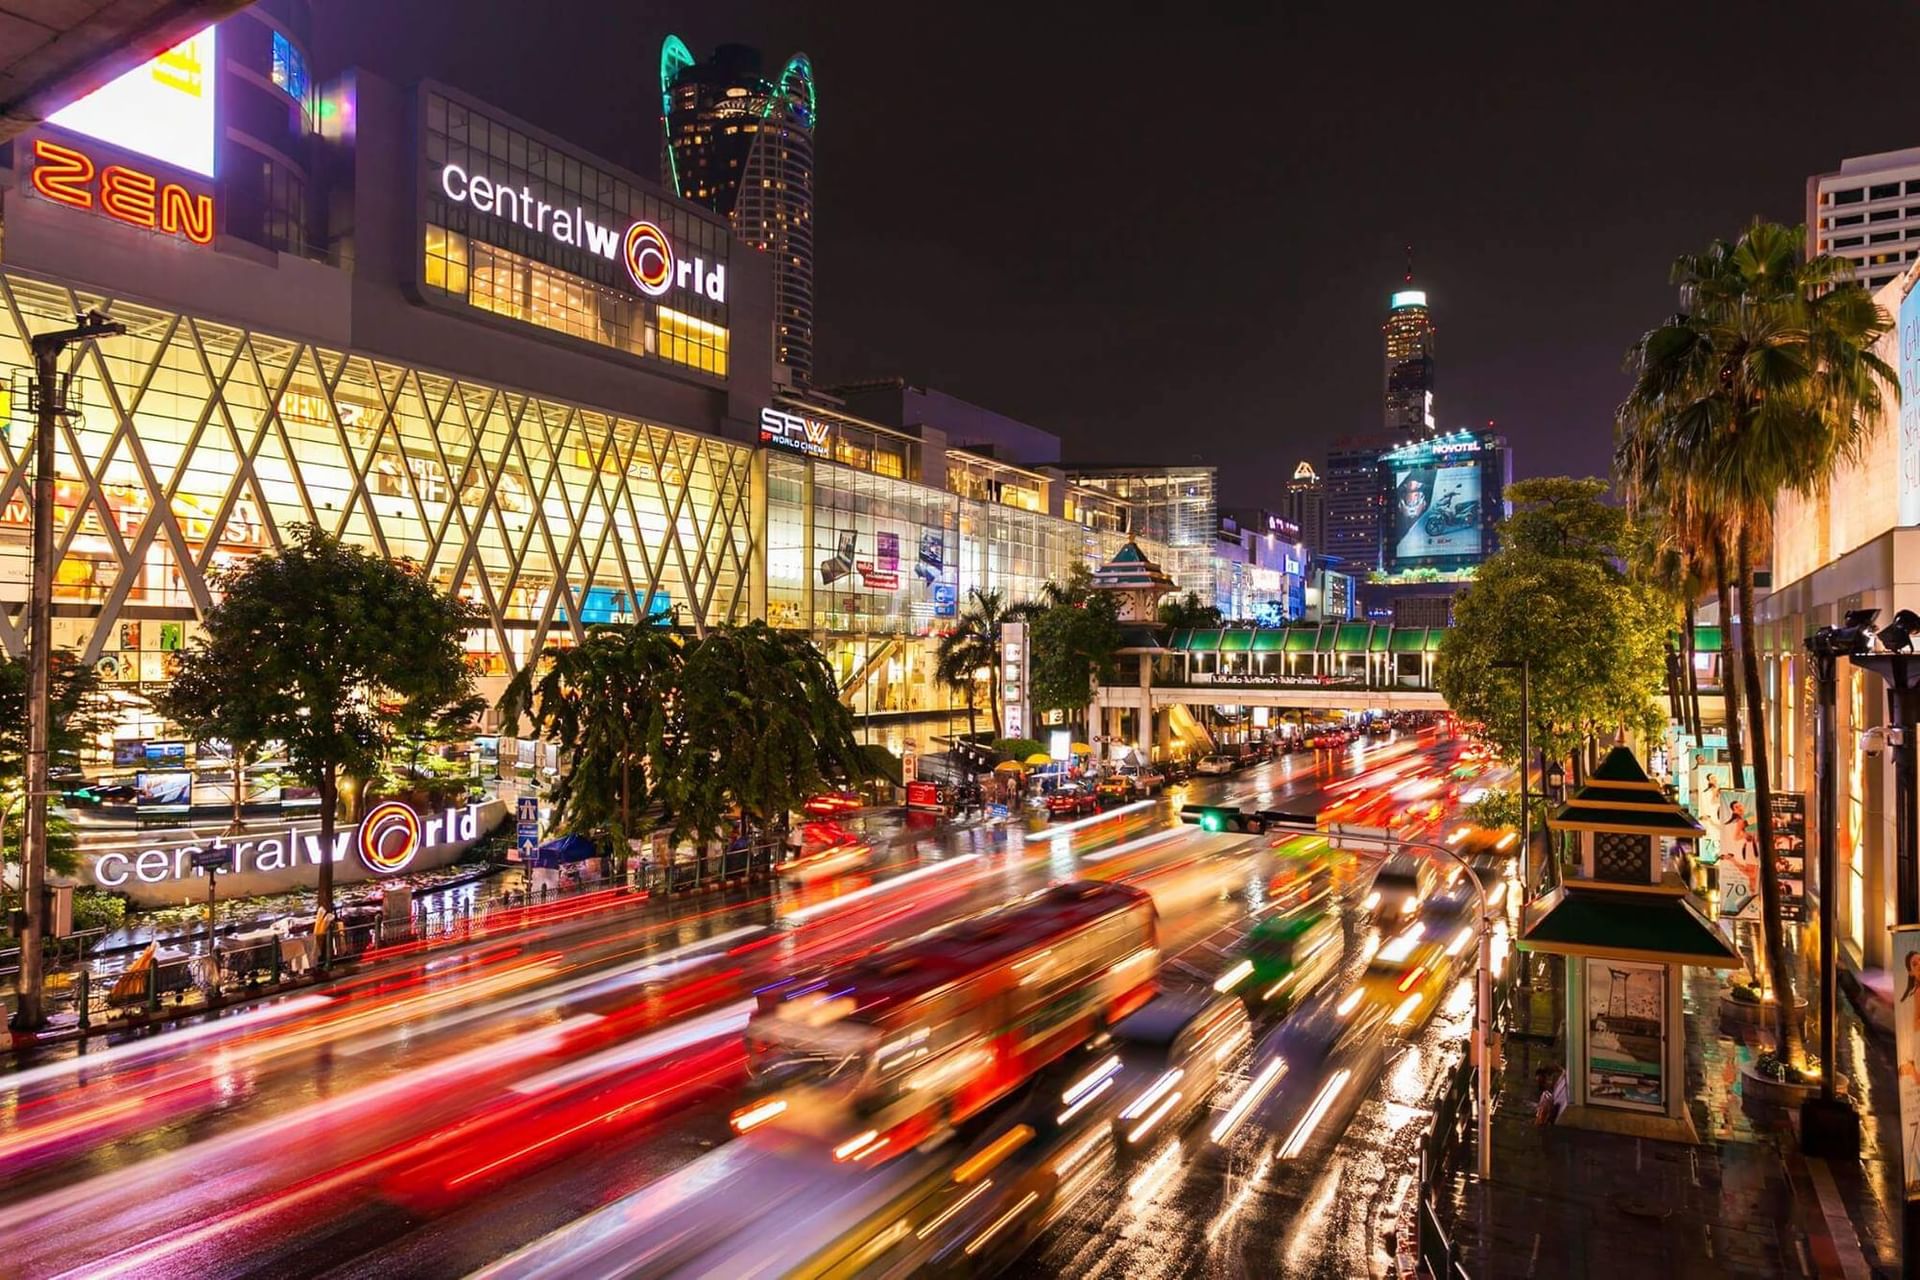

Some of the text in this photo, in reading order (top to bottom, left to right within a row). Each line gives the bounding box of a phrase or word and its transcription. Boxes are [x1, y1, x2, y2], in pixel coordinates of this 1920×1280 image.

[32, 140, 213, 244] ZEN
[773, 435, 800, 448] WORLD
[800, 442, 829, 455] CINEMA
[1433, 441, 1481, 454] NOVOTEL
[1726, 882, 1747, 898] 70
